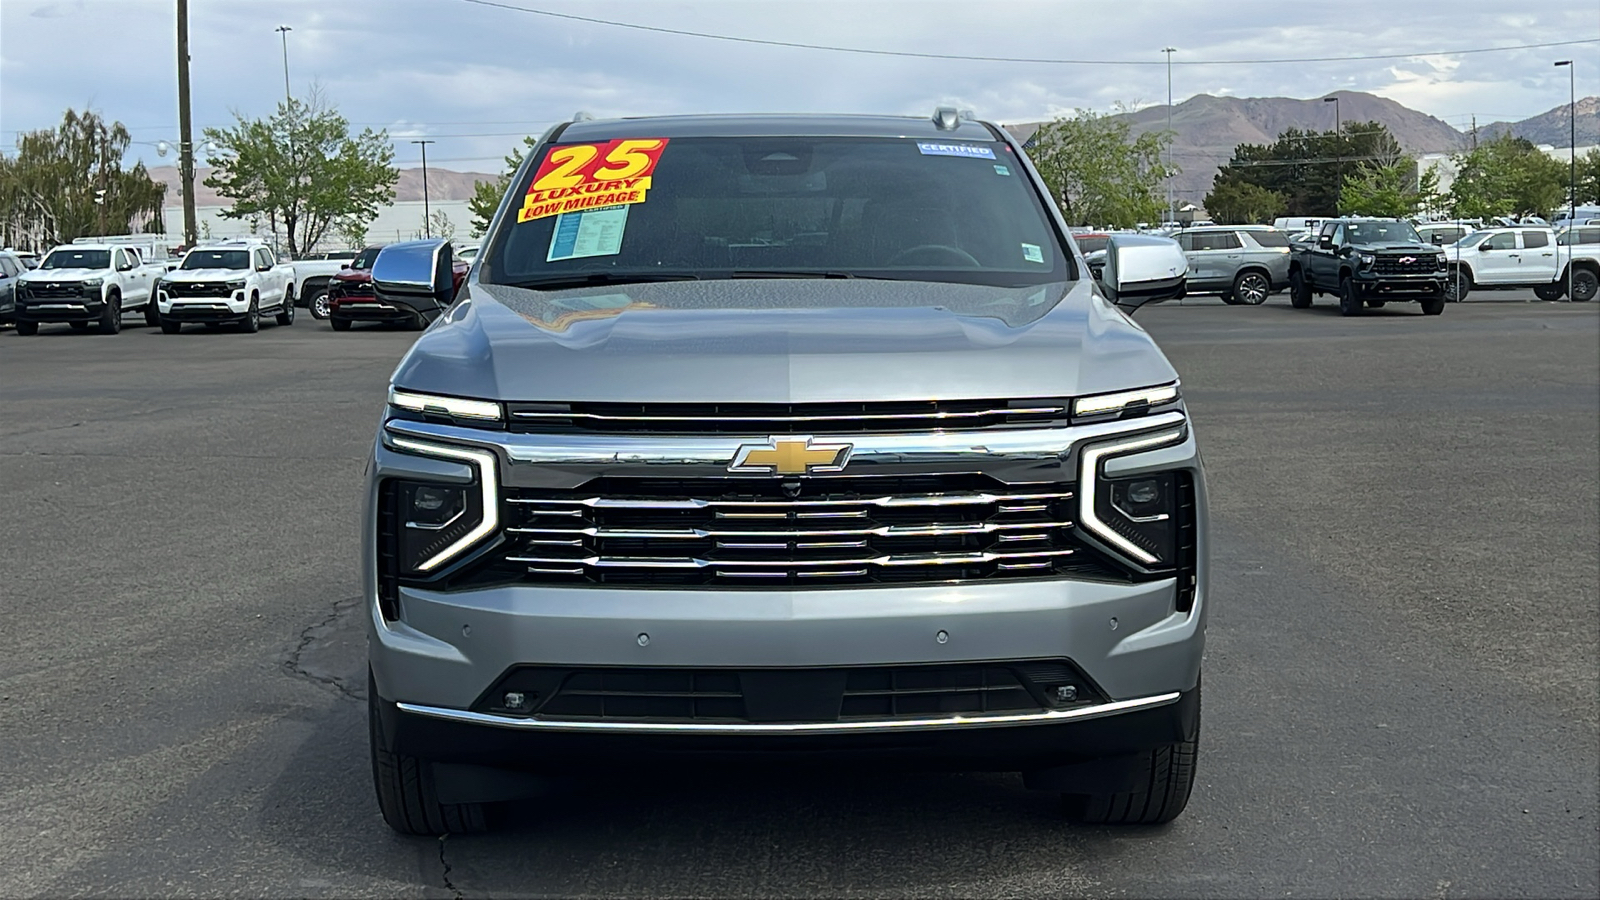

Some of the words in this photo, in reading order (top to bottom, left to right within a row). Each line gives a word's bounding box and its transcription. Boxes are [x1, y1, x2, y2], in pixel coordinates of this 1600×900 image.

[921, 144, 990, 154] CERTIFIED
[533, 140, 663, 190] 25
[532, 178, 639, 204] LUXURY
[524, 202, 562, 219] LOW
[564, 191, 639, 210] MILEAGE
